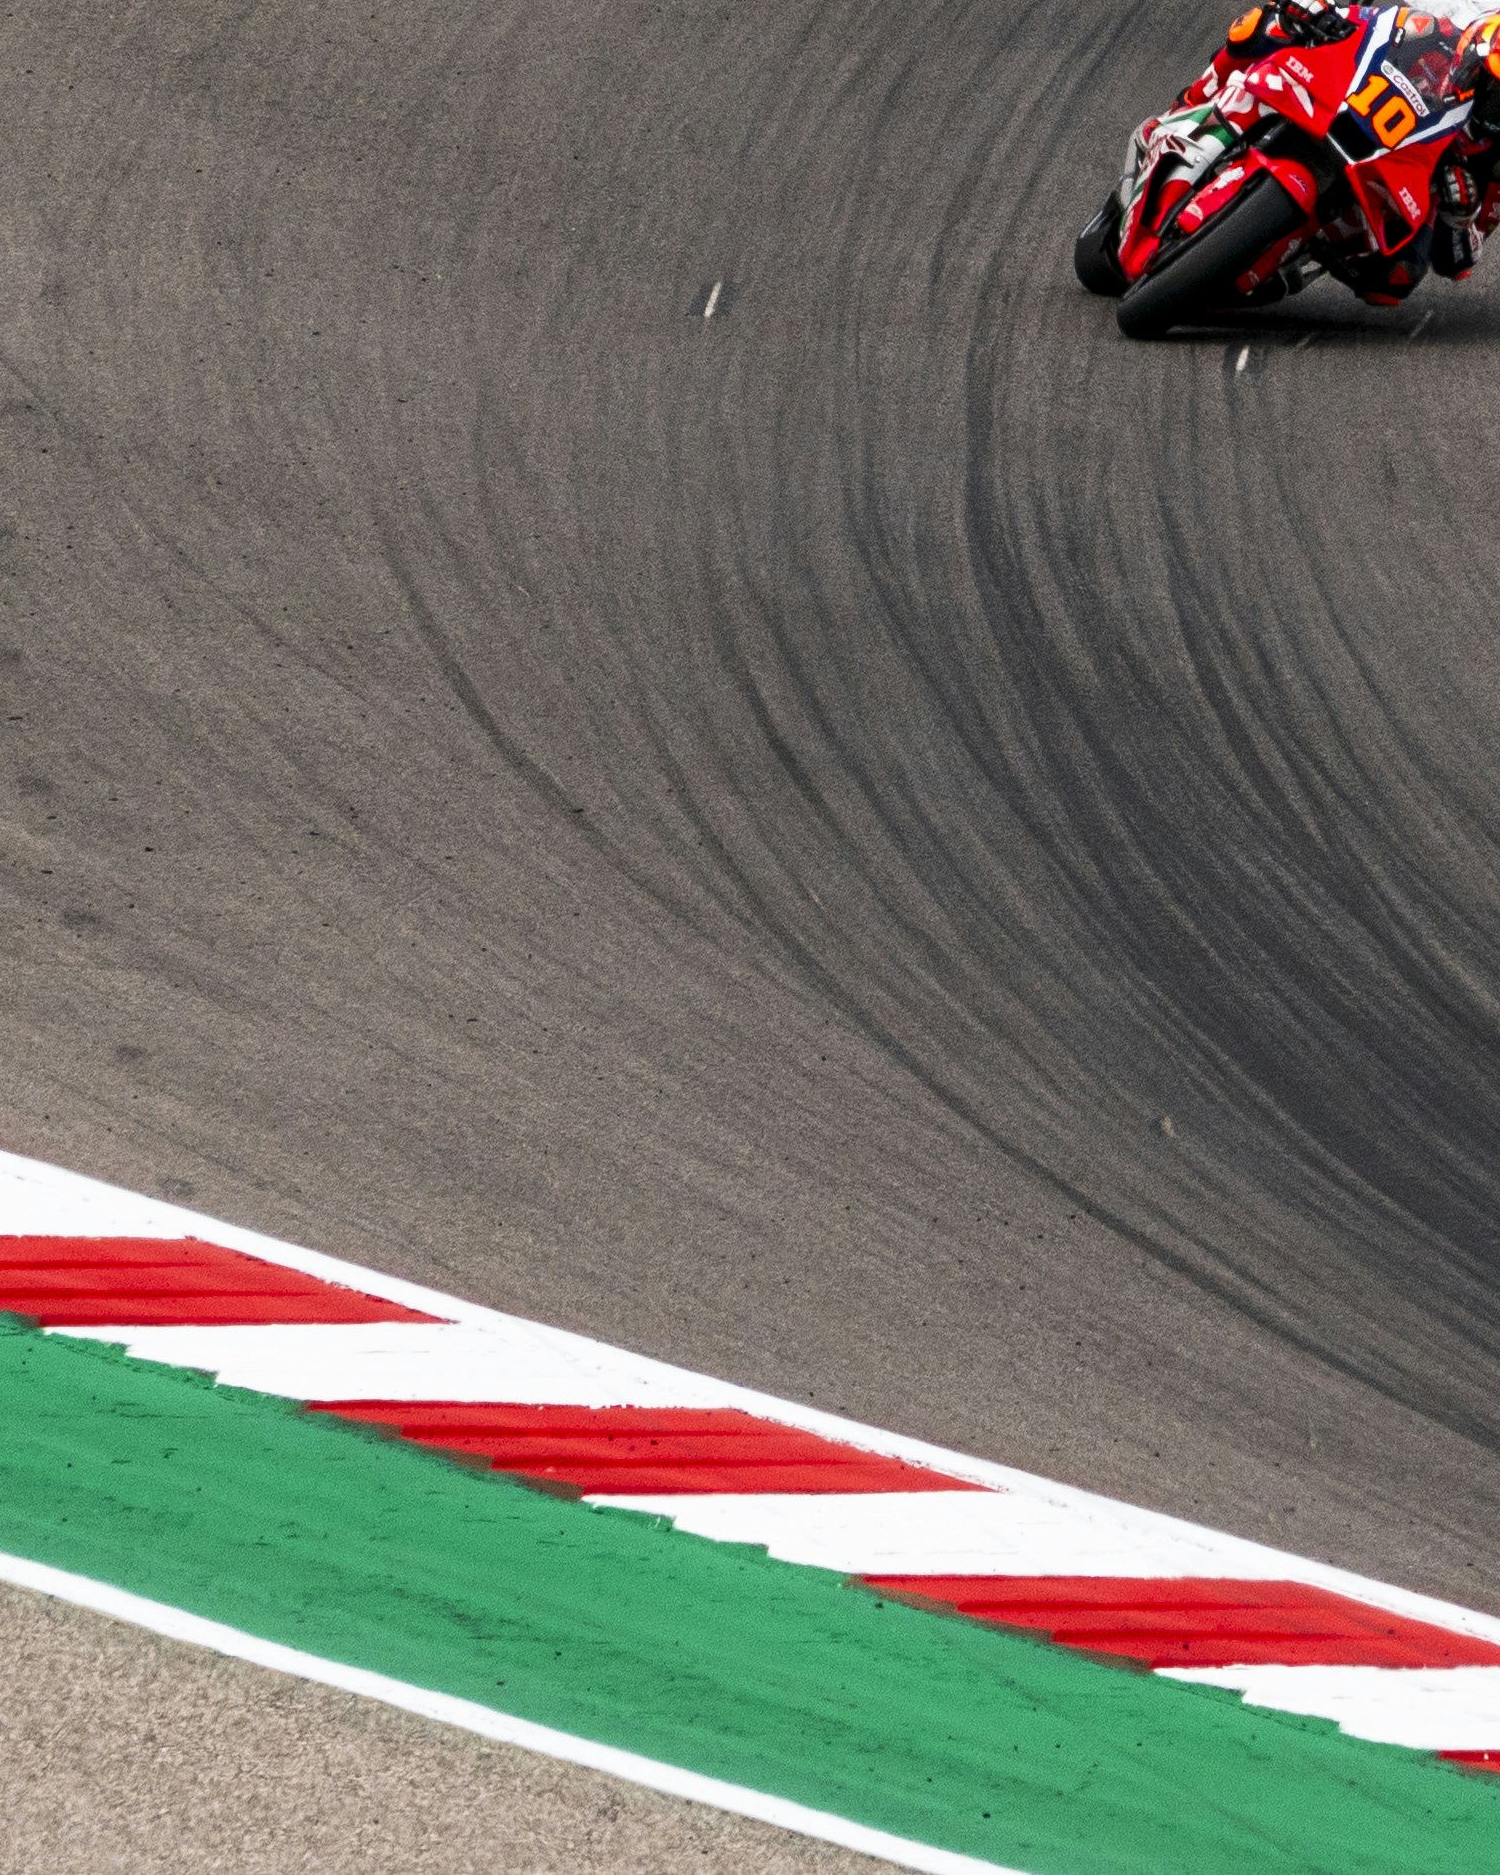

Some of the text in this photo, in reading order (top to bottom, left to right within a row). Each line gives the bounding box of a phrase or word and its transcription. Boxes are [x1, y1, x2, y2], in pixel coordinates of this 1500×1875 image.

[1285, 56, 1314, 83] IBM
[1346, 74, 1417, 150] 10
[1393, 74, 1426, 116] Castrol
